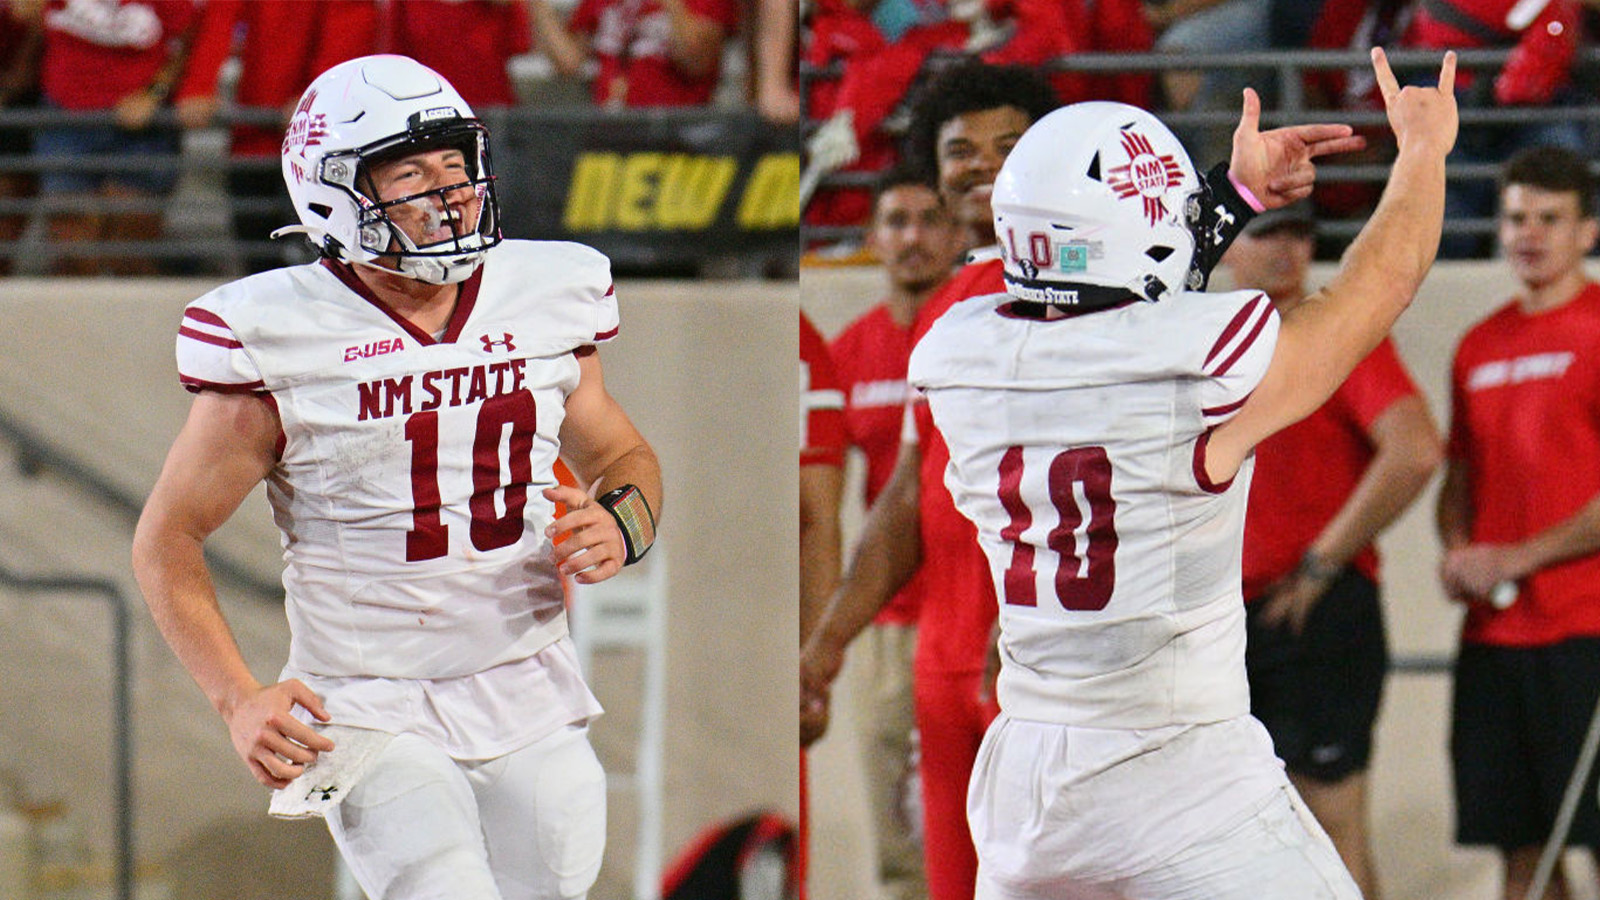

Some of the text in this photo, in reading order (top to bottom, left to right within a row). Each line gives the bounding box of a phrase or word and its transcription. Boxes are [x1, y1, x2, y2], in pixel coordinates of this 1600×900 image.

[564, 152, 738, 231] NEW
[1135, 160, 1163, 179] NM
[1138, 176, 1165, 191] STATE
[1007, 227, 1053, 269] 10
[357, 358, 526, 421] NM STATE
[404, 387, 537, 562] 10
[997, 445, 1119, 611] 10
